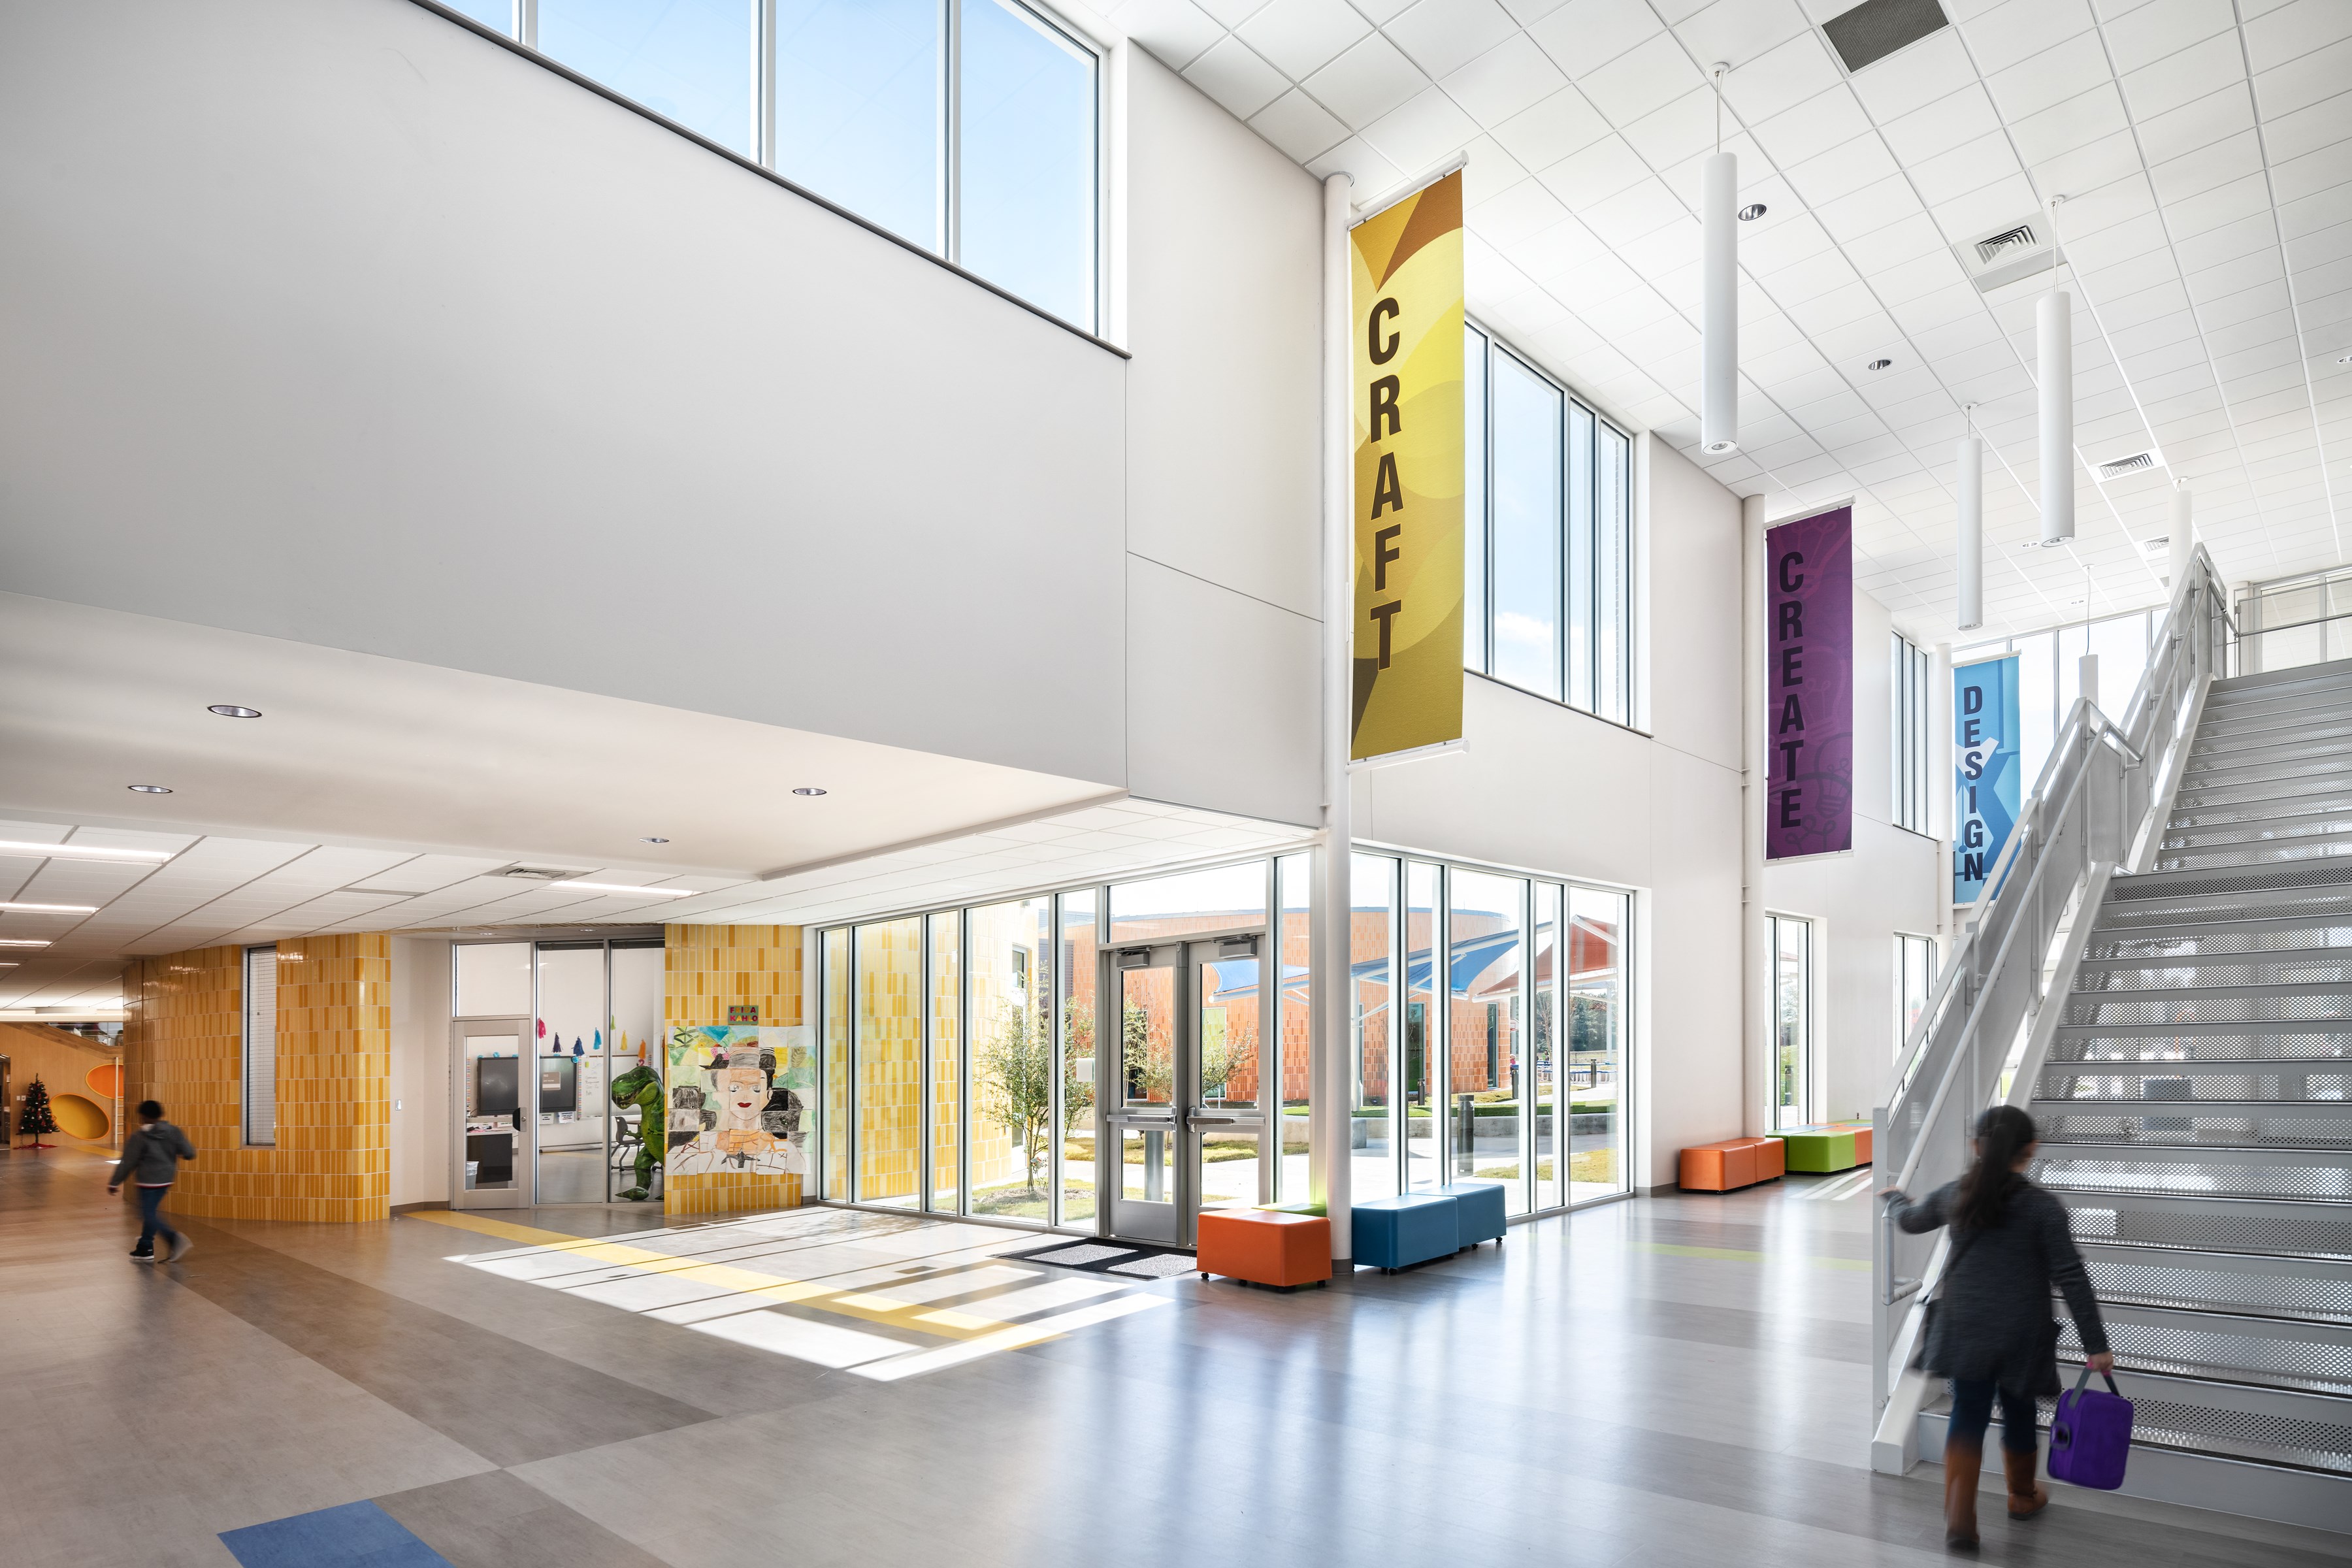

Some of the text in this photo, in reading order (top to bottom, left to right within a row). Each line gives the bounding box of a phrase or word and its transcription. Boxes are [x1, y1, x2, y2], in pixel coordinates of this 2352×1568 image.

[1369, 297, 1404, 671] CRAFT
[1779, 551, 1805, 829] CREATE
[1963, 685, 1984, 882] DESIGN
